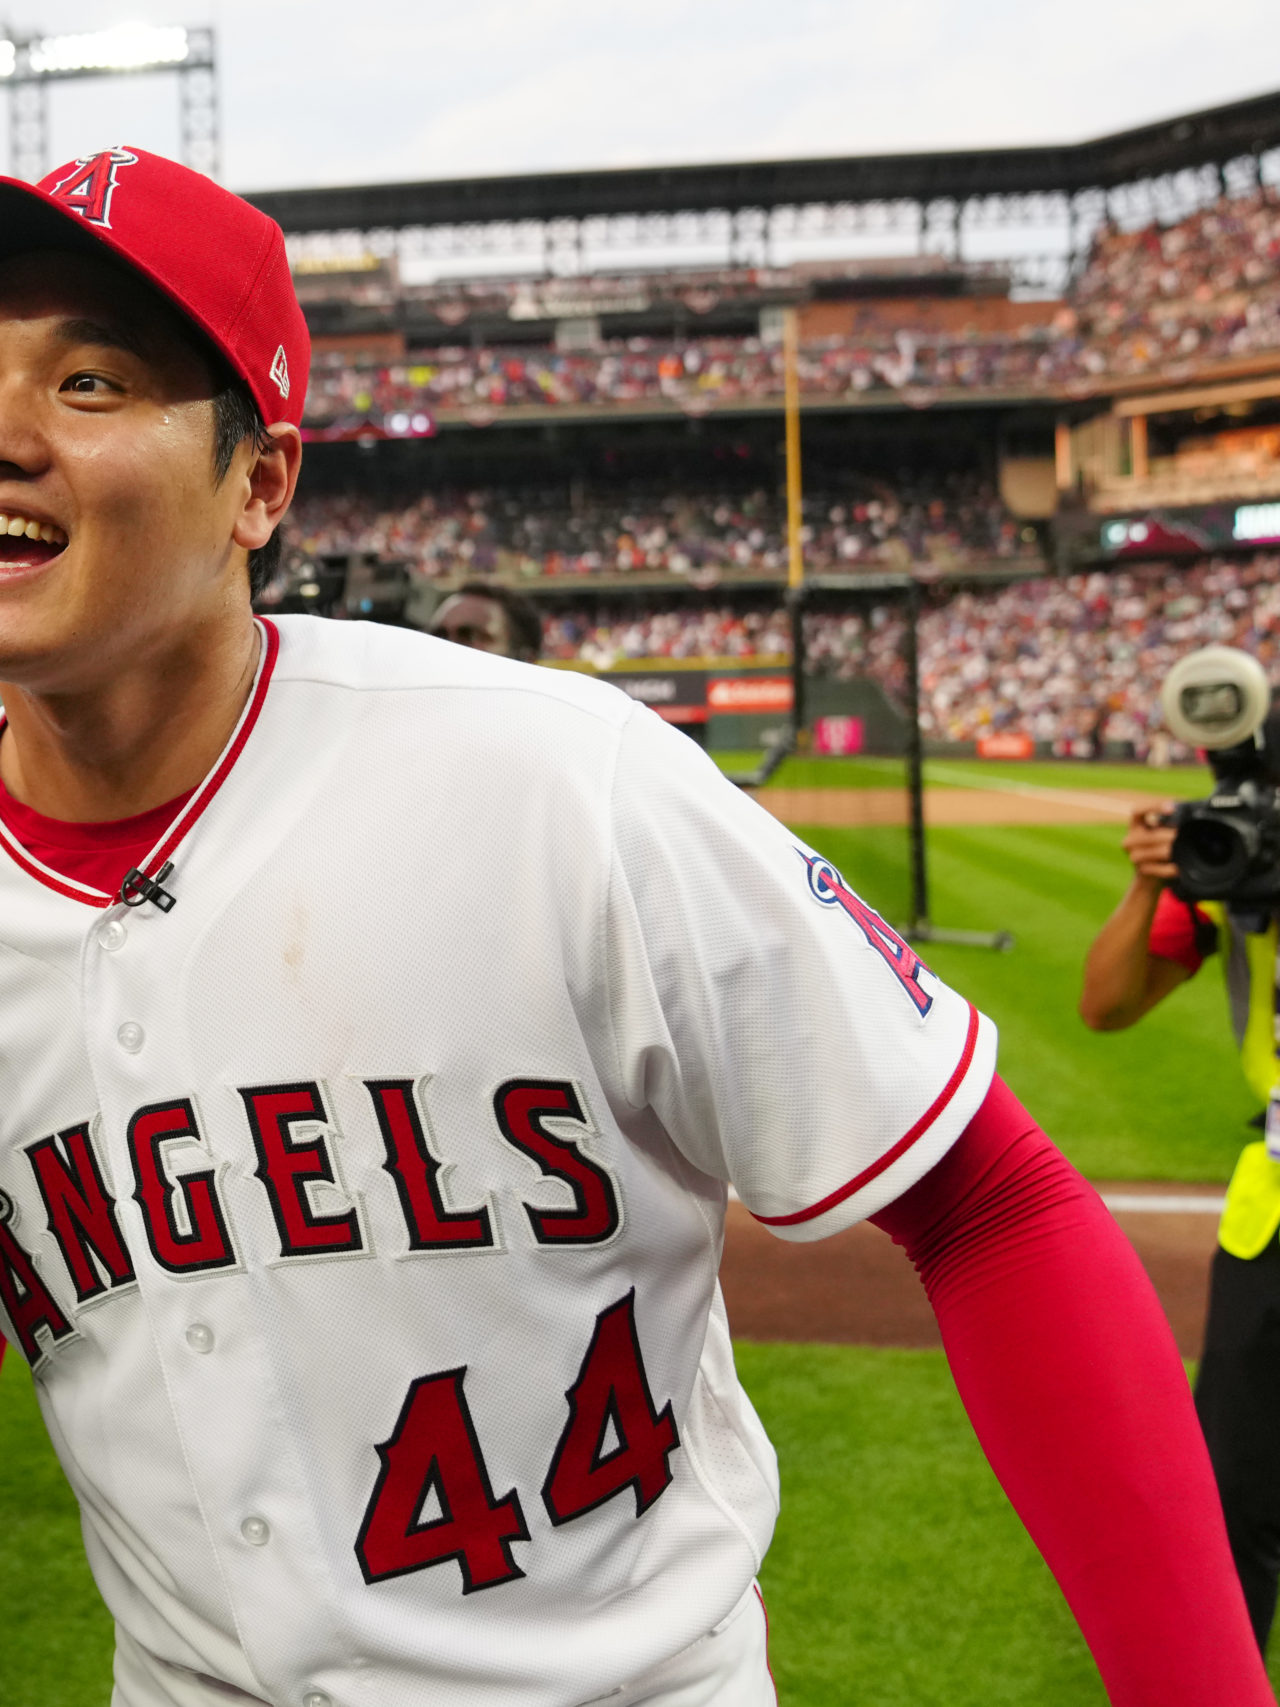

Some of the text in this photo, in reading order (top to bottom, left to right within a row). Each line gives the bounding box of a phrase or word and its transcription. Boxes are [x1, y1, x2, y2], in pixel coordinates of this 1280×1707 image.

[49, 147, 138, 229] A
[791, 845, 937, 1018] A
[354, 1285, 681, 1596] 44
